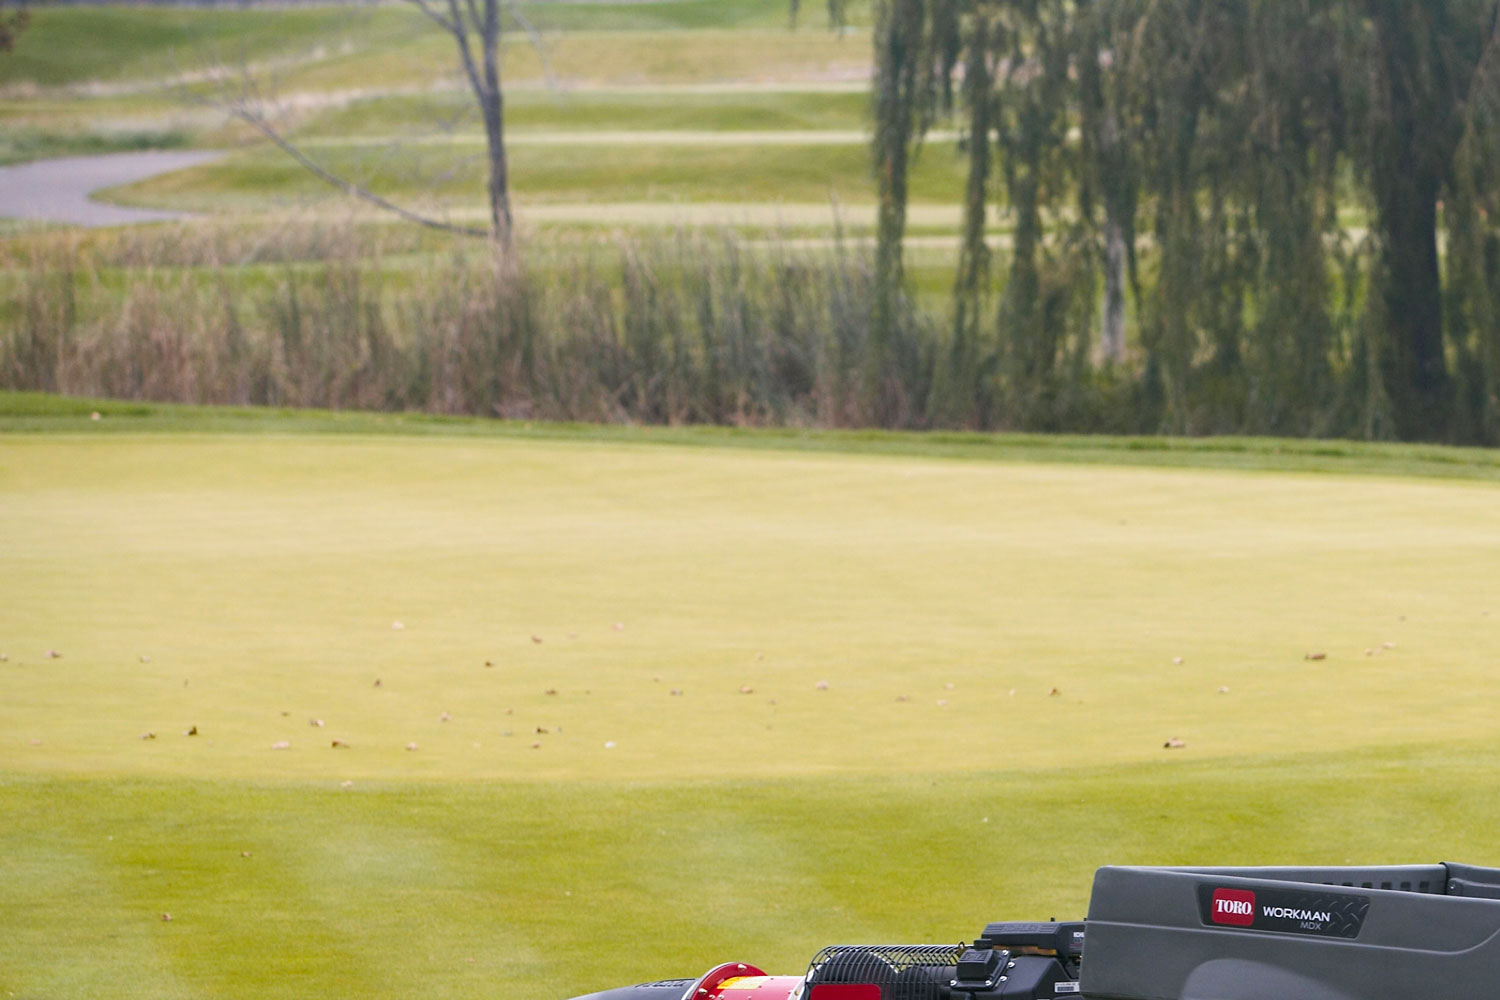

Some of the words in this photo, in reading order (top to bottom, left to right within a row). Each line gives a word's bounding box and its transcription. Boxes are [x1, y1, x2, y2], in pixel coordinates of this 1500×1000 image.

[1215, 899, 1252, 915] TORO
[1263, 906, 1331, 922] WORKMAN
[1300, 922, 1321, 930] MDX
